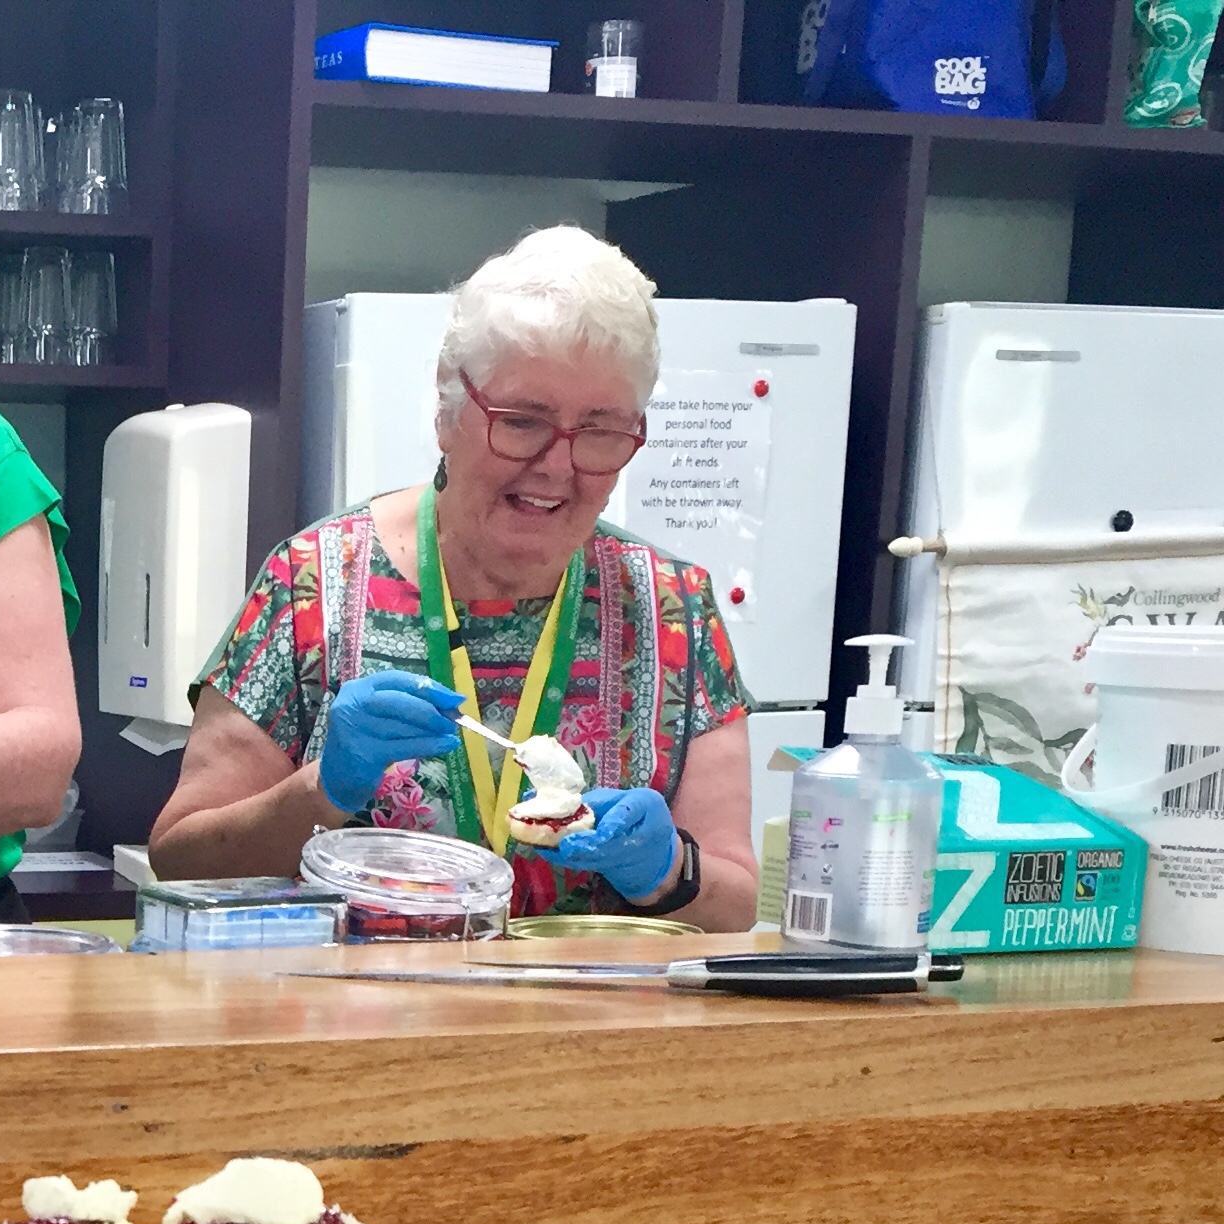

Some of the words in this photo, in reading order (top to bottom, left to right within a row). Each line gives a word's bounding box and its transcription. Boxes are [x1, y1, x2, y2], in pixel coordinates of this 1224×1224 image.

[935, 57, 983, 75] COOL
[935, 72, 987, 95] BAG
[679, 400, 700, 411] take
[702, 399, 729, 411] home
[731, 402, 753, 413] your
[665, 419, 708, 430] personal
[710, 418, 732, 430] food
[647, 438, 698, 449] containers
[700, 437, 723, 449] after
[726, 440, 748, 450] your
[649, 478, 668, 490] Any
[670, 478, 721, 489] containers
[641, 496, 663, 507] with
[665, 496, 677, 507] be
[679, 496, 714, 507] thrown
[1133, 587, 1221, 609] Collingwood
[1009, 852, 1065, 883] ZOETIC
[1077, 851, 1123, 868] ORGANIC
[1006, 884, 1062, 903] INFUSIONS
[1001, 905, 1119, 947] PEPPERMINT
